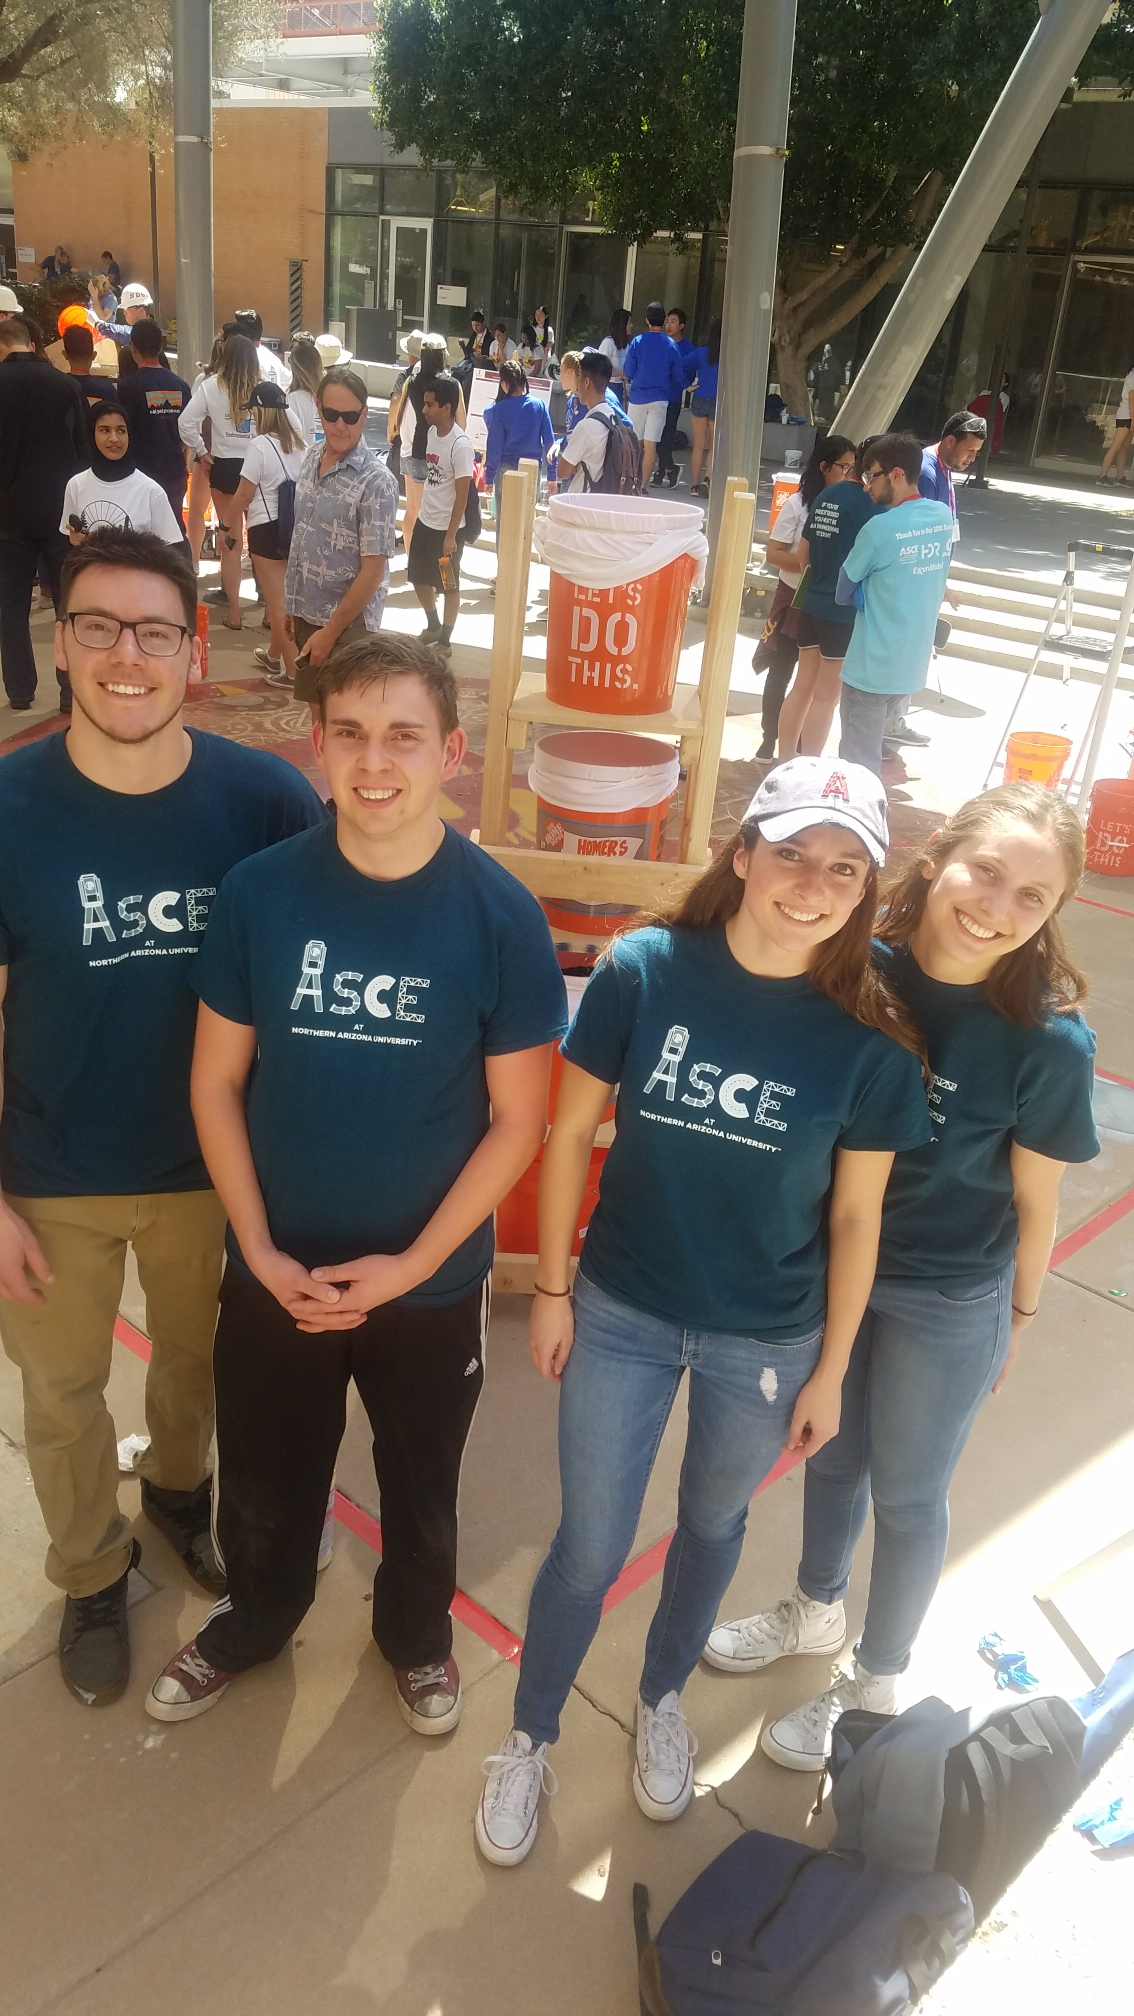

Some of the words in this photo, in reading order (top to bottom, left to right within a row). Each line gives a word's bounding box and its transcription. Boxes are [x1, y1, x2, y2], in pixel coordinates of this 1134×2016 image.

[895, 531, 912, 539] Thank
[900, 544, 918, 556] ASCE
[570, 605, 637, 656] DO
[568, 656, 639, 690] THIS.
[821, 771, 850, 802] A
[1096, 831, 1127, 854] DO
[77, 873, 216, 946] ASCE
[89, 952, 129, 967] NORTHERN
[130, 948, 168, 957] ARIZONA
[290, 940, 430, 1023] ASCE
[292, 1027, 336, 1038] NORTHERN
[337, 1032, 372, 1042] ARIZONA
[643, 1025, 796, 1132] ASCE
[640, 1109, 684, 1127] NORTHERN
[686, 1122, 724, 1138] ARIZONA
[704, 1118, 715, 1126] AT
